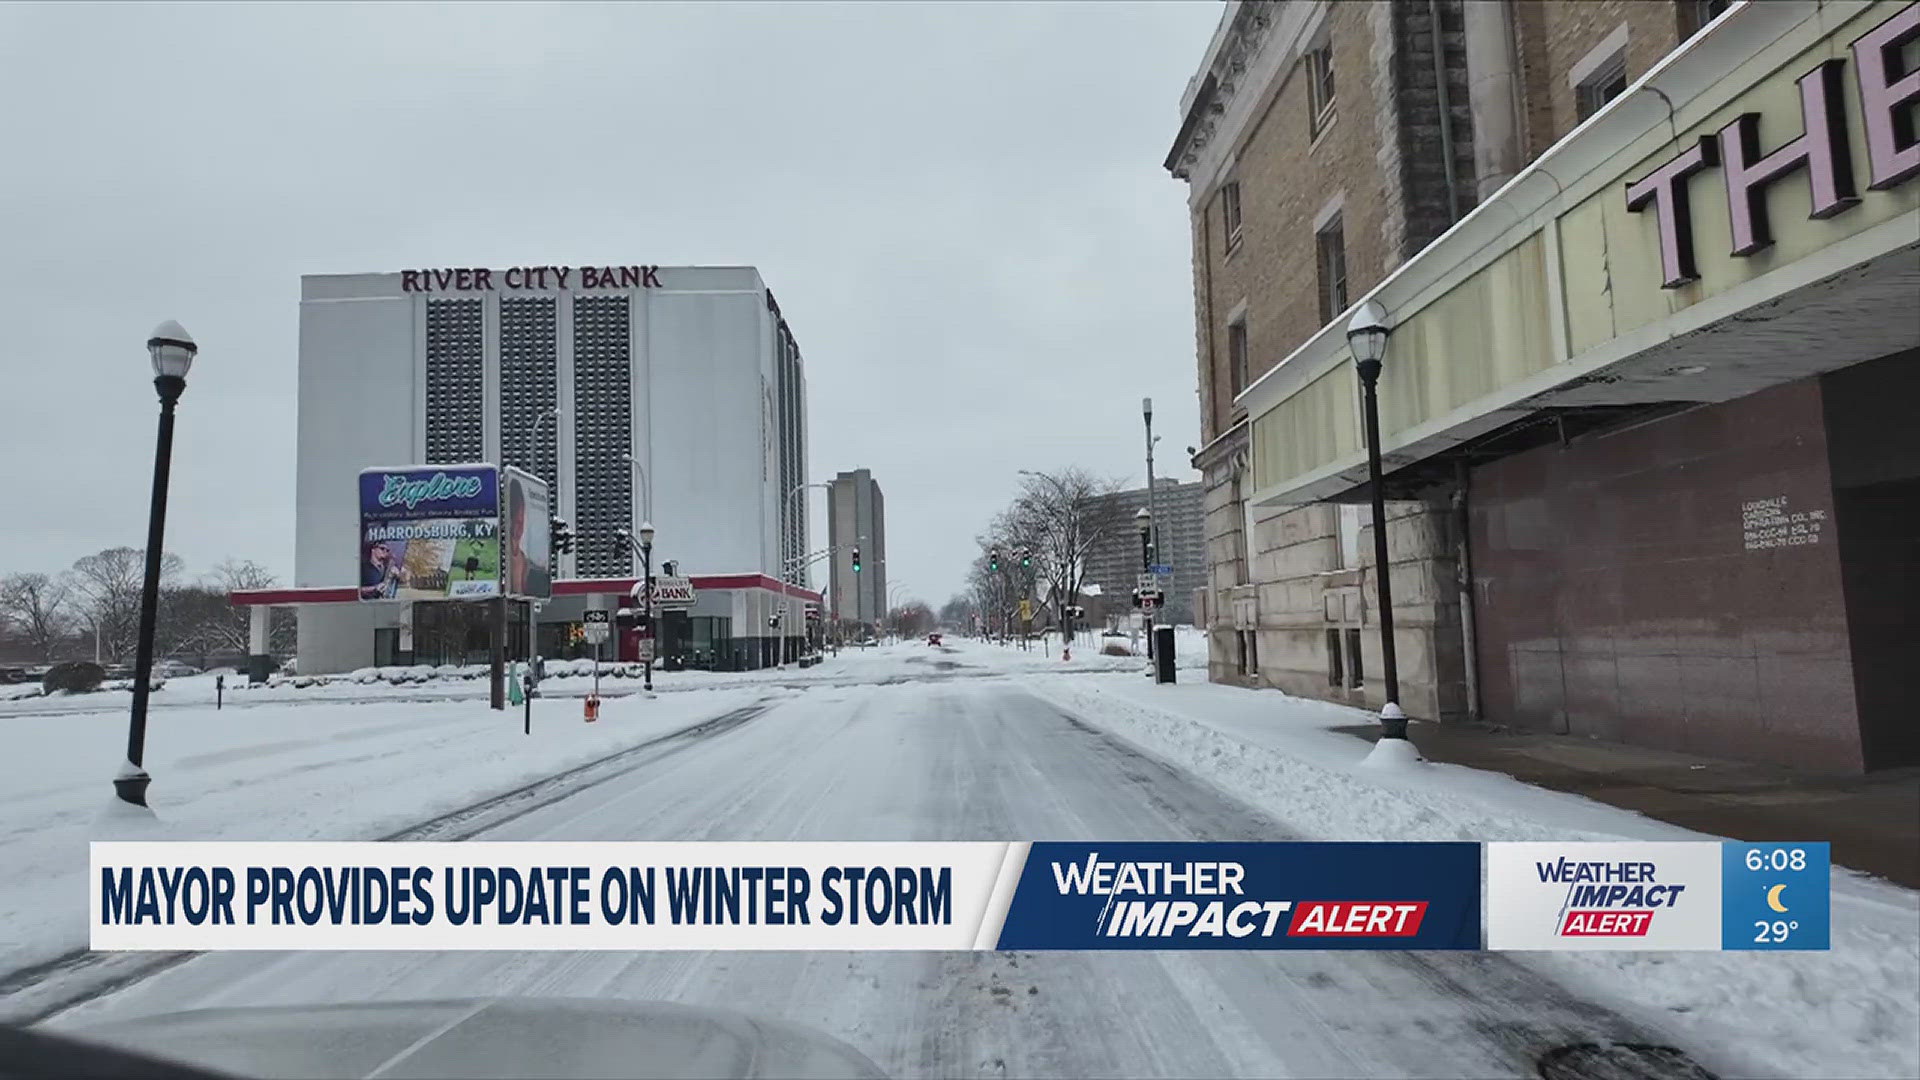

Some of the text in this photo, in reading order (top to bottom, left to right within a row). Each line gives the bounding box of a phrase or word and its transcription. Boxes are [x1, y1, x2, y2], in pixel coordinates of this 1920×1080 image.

[1625, 0, 1920, 289] THE
[401, 265, 663, 292] RIVER CITY BANK
[379, 472, 481, 509] Explore
[368, 524, 494, 541] HARRODSBURG, KY
[661, 587, 691, 599] BANK
